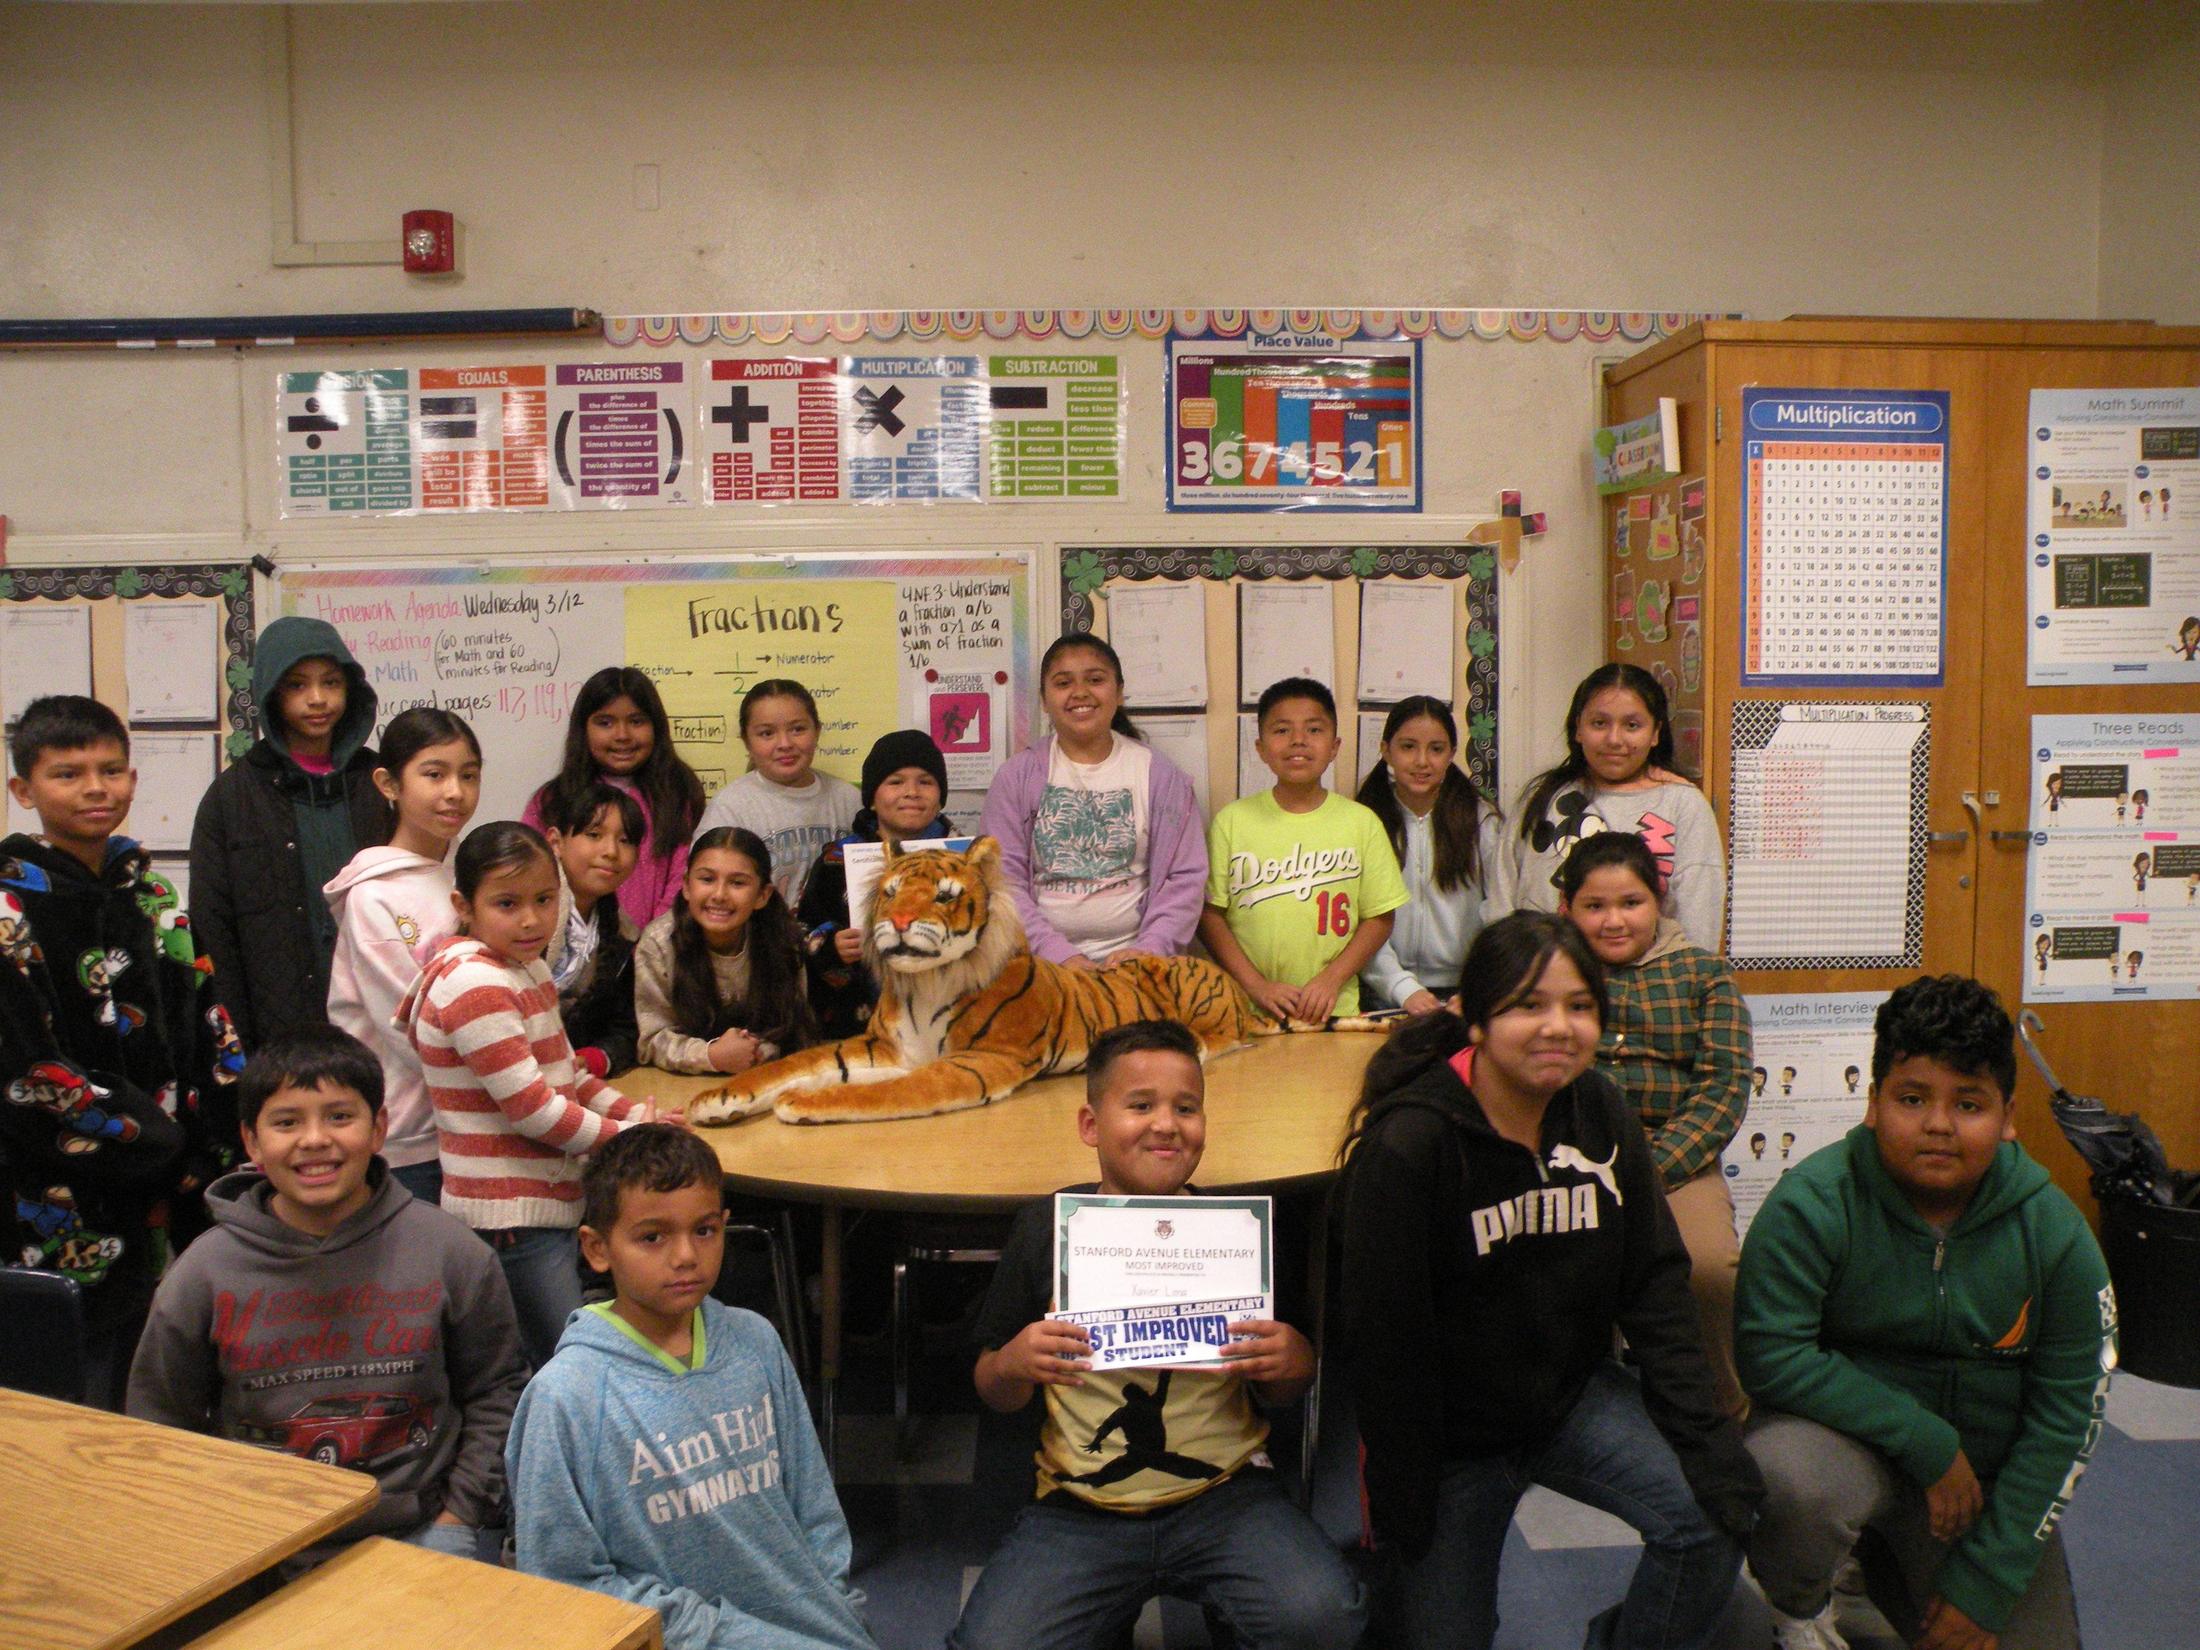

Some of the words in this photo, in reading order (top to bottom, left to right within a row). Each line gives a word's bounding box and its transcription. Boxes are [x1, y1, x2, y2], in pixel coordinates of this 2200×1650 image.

[1254, 336, 1291, 347] Place
[1294, 336, 1334, 347] Value
[862, 361, 965, 375] MULTIPLICATON
[1005, 360, 1098, 374] SUBTRACTION
[1180, 357, 1214, 365] Millions
[576, 367, 662, 382] PARENTHESIS
[744, 362, 803, 377] ADDITION
[1214, 368, 1251, 376] Hundred
[458, 370, 508, 385] EQUALS
[1071, 385, 1113, 393] decrease
[602, 401, 638, 409] difference
[1071, 405, 1090, 413] less
[1092, 405, 1114, 413] than
[2088, 399, 2125, 411] Math
[2131, 398, 2185, 410] Summit
[1349, 412, 1369, 420] Tens
[1777, 404, 1916, 428] Multiplication
[602, 423, 638, 431] difference
[1072, 425, 1114, 433] difference
[1381, 423, 1403, 431] Ones
[610, 440, 622, 448] the
[1026, 445, 1056, 453] deduct
[1767, 479, 1773, 488] 0
[1782, 479, 1787, 488] 1
[1795, 480, 1800, 488] 2
[1809, 480, 1814, 488] 3
[1823, 480, 1828, 488] 4
[1837, 480, 1842, 489] 5
[1850, 480, 1856, 489] 6
[1864, 480, 1870, 489] 7
[1878, 481, 1883, 489] 8
[1891, 481, 1897, 489] 9
[1903, 481, 1913, 490] 10
[1917, 481, 1926, 489] 11
[1931, 481, 1940, 490] 12
[1794, 513, 1800, 521] 6
[1808, 512, 1814, 521] 9
[1821, 513, 1830, 522] 12
[1835, 513, 1844, 522] 15
[1862, 513, 1871, 522] 21
[1875, 513, 1885, 522] 24
[1889, 513, 1898, 523] 27
[950, 579, 1011, 598] Understand
[317, 594, 395, 624] Homework
[405, 591, 461, 628] Agenda
[464, 590, 539, 623] Wednesday
[545, 590, 584, 614] 3/12
[688, 595, 844, 638] Fractions
[899, 609, 908, 622] a
[913, 603, 955, 620] fraction
[966, 600, 992, 616] a/b
[901, 622, 931, 638] with
[941, 618, 965, 634] a>1
[971, 620, 985, 632] as
[992, 618, 1000, 632] a
[367, 630, 431, 661] Reading
[464, 631, 513, 646] minutes
[903, 640, 931, 653] sum
[937, 636, 949, 650] of
[958, 634, 1003, 650] fraction
[437, 653, 450, 665] for
[455, 649, 481, 663] Math
[486, 648, 504, 659] and
[510, 644, 525, 659] 60
[735, 651, 740, 672] 1
[776, 651, 835, 667] Numerator
[910, 653, 930, 669] 1/b
[375, 660, 418, 683] Math
[446, 666, 490, 680] minutes
[494, 661, 507, 676] for
[733, 677, 749, 695] 2
[377, 689, 439, 717] ucceed
[445, 693, 492, 720] pages
[499, 686, 526, 723] 117,
[1799, 707, 1869, 721] MULTIPLICATION
[1874, 707, 1914, 721] PROGRESS
[673, 720, 720, 740] Fraction
[2092, 722, 2132, 734] Three
[2138, 722, 2184, 734] Reads
[819, 746, 858, 757] number
[1230, 843, 1361, 903] Dodgers
[1316, 890, 1350, 937] 16
[1770, 1002, 1809, 1016] Math
[1471, 1183, 1599, 1256] PUMA
[1074, 1246, 1132, 1258] STANFORD
[1135, 1247, 1182, 1259] AVENUE
[1183, 1248, 1255, 1260] ELEMENTARY
[1125, 1261, 1152, 1271] MOST
[1155, 1262, 1204, 1272] IMPROVED
[1056, 1308, 1124, 1324] STANFORD
[1128, 1304, 1177, 1320] AVENUE
[1179, 1296, 1264, 1316] ELEMENTARY
[1084, 1324, 1117, 1351] ST
[1124, 1315, 1230, 1347] IMPROVED
[1103, 1342, 1189, 1363] STUDENT
[249, 1374, 289, 1390] MAX
[293, 1365, 345, 1383] SPEED
[628, 1431, 720, 1486] Aim
